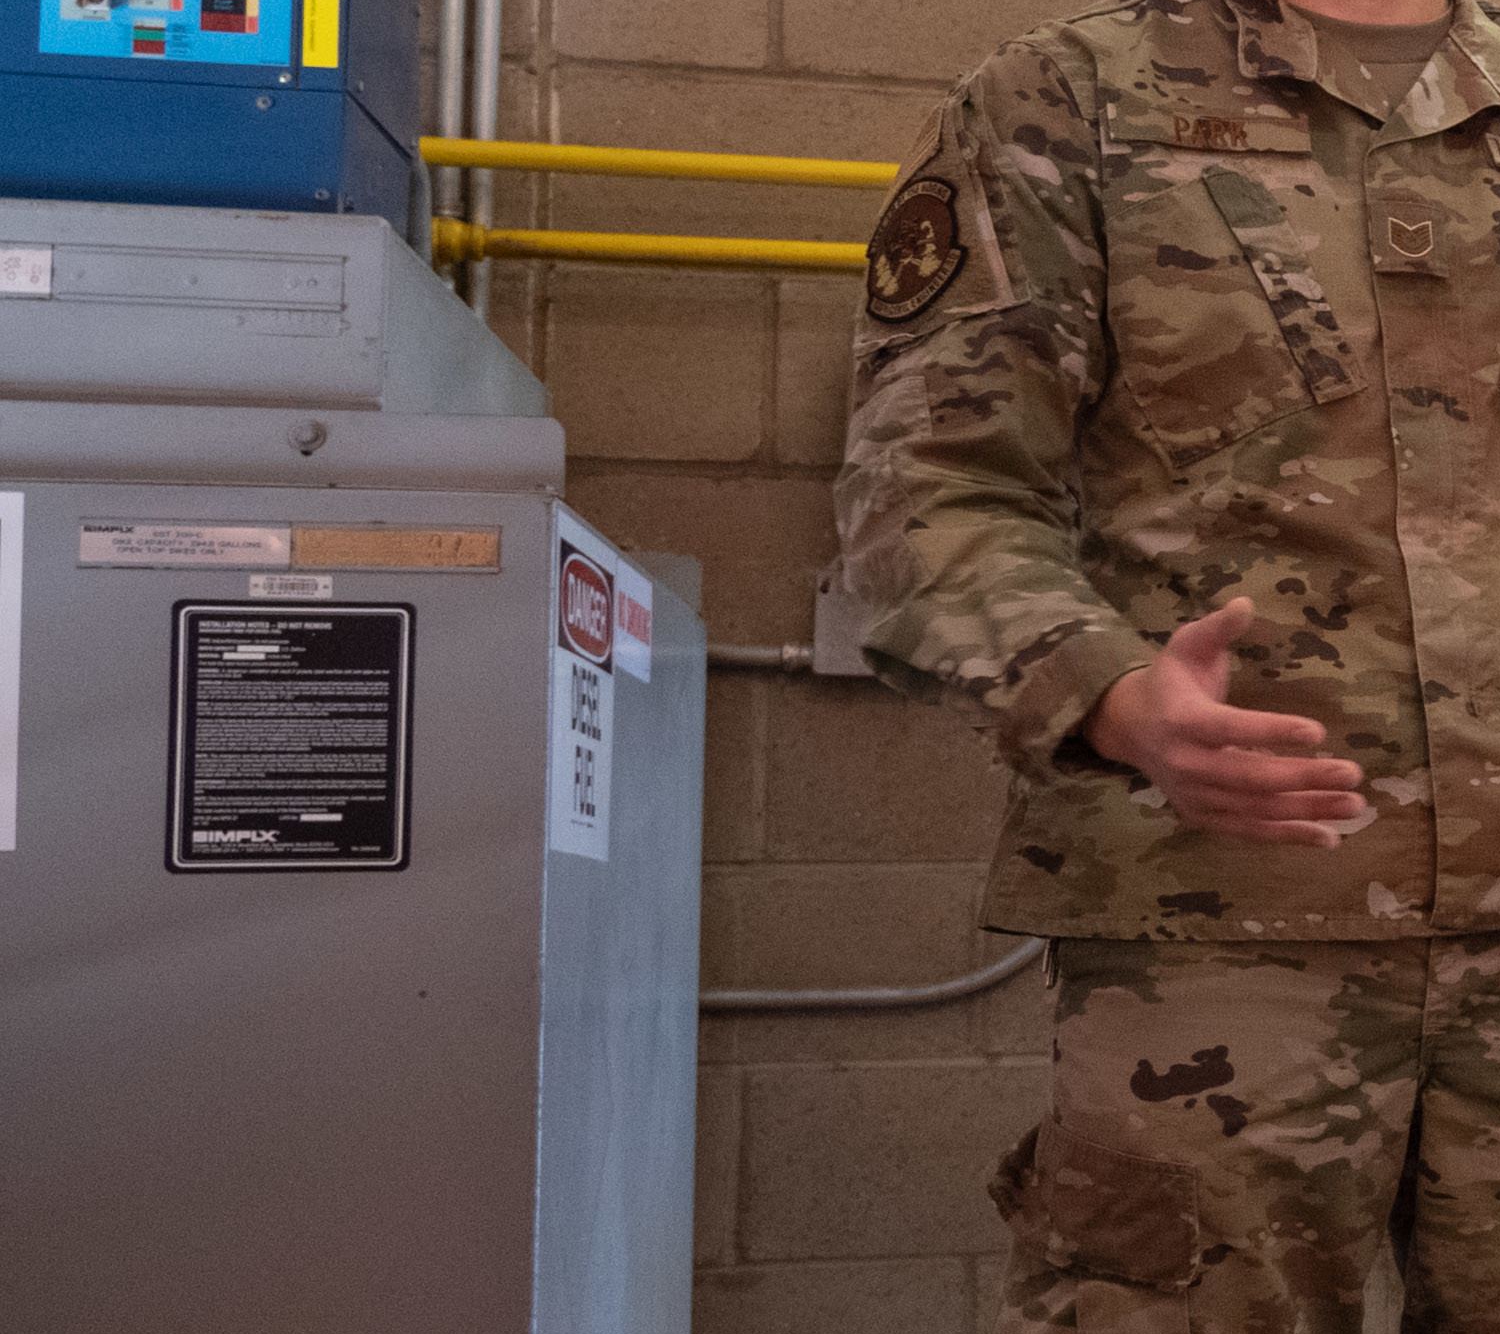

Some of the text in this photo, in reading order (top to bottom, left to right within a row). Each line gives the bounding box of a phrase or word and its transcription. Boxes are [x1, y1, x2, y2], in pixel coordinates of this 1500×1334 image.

[1173, 116, 1249, 148] PARK
[568, 572, 607, 641] DANGER
[571, 663, 601, 742] DIESEL
[573, 744, 596, 818] FUEL
[192, 830, 277, 843] SIMPLX
